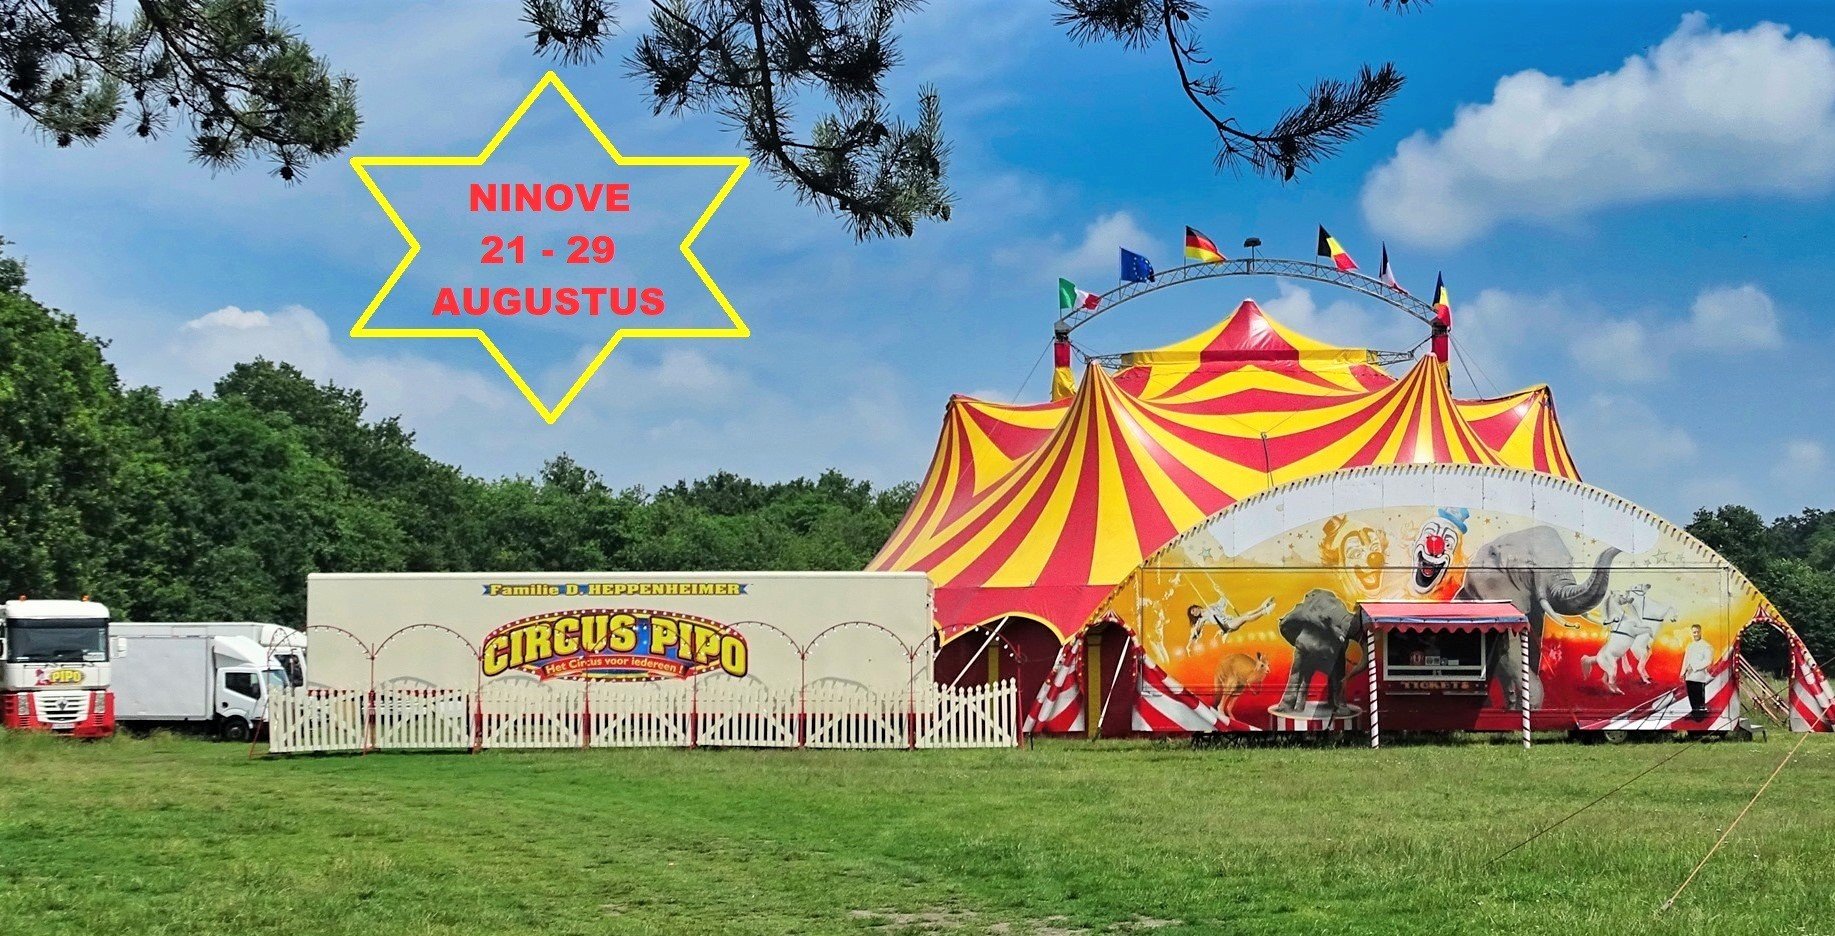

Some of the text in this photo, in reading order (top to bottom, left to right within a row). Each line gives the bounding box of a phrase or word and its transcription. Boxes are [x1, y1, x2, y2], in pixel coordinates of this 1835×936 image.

[490, 583, 740, 596] Familie D. HEPPENHEIMER
[483, 613, 748, 678] CIRCUS PIPO
[545, 662, 566, 674] Het
[604, 657, 629, 665] voor
[631, 656, 677, 672] iedereen
[52, 670, 81, 683] PIPO
[1401, 681, 1470, 689] TICKETS
